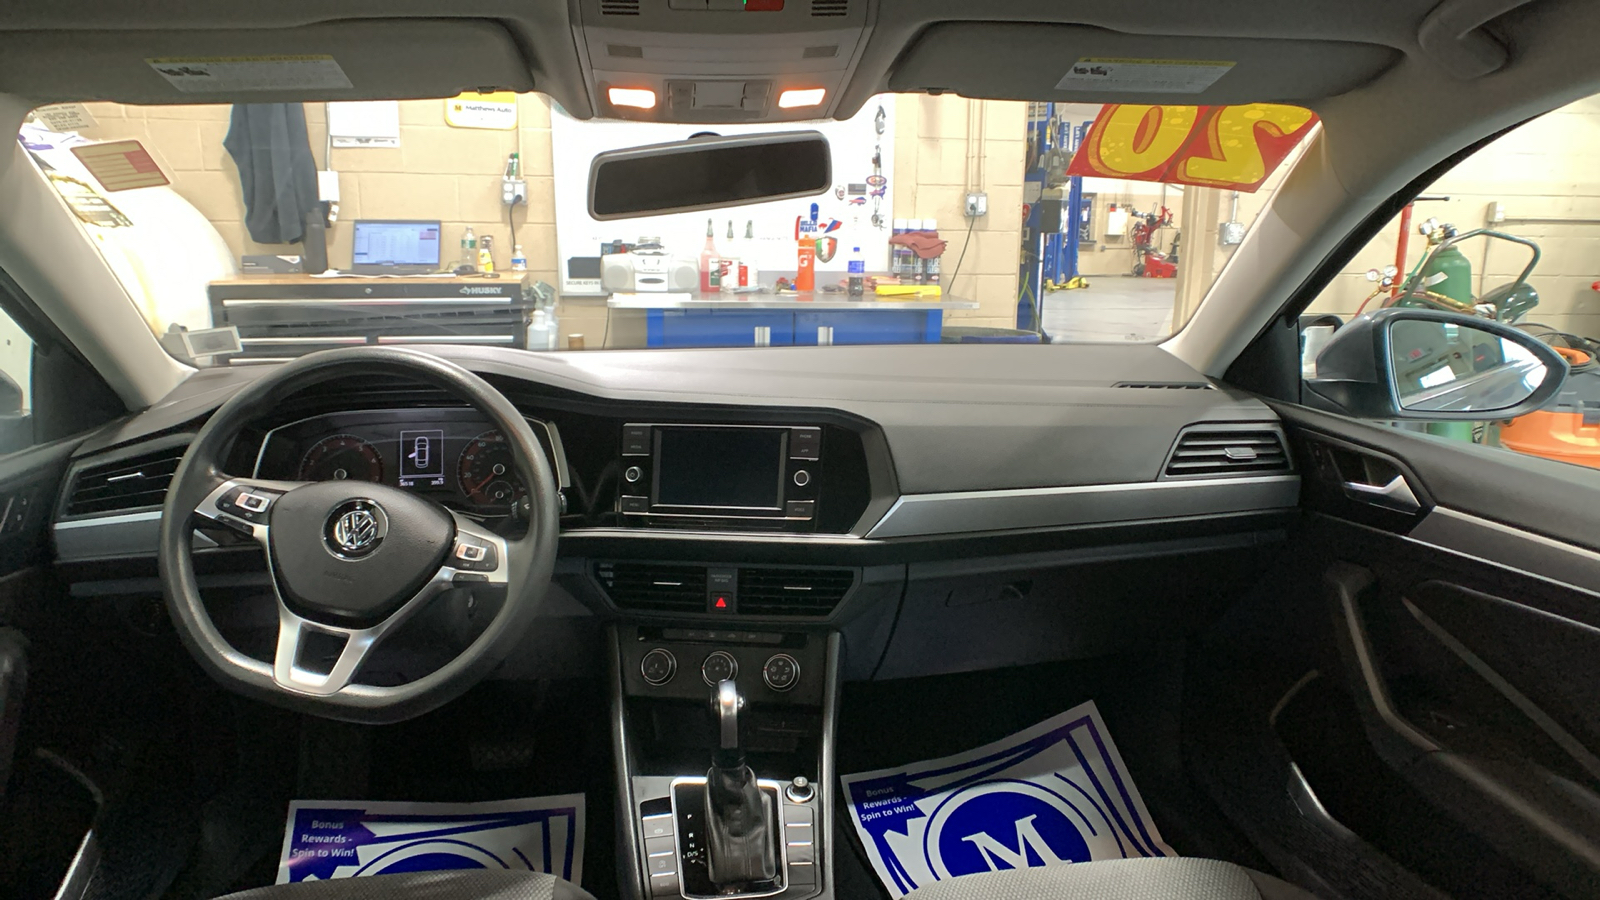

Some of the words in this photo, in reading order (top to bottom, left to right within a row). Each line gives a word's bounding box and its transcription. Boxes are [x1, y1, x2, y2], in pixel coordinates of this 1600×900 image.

[465, 104, 496, 112] Matthews
[471, 287, 502, 295] HUSKY
[866, 785, 895, 798] Bonus
[863, 795, 904, 810] Rewards
[860, 809, 881, 823] Spin
[882, 807, 893, 818] to
[893, 802, 916, 816] Win!
[311, 818, 344, 830] Bonus
[300, 832, 346, 844] Rewards
[688, 831, 694, 839] R
[961, 813, 1072, 871] M
[291, 847, 315, 859] Spin
[316, 848, 329, 858] to
[330, 846, 355, 858] Win!
